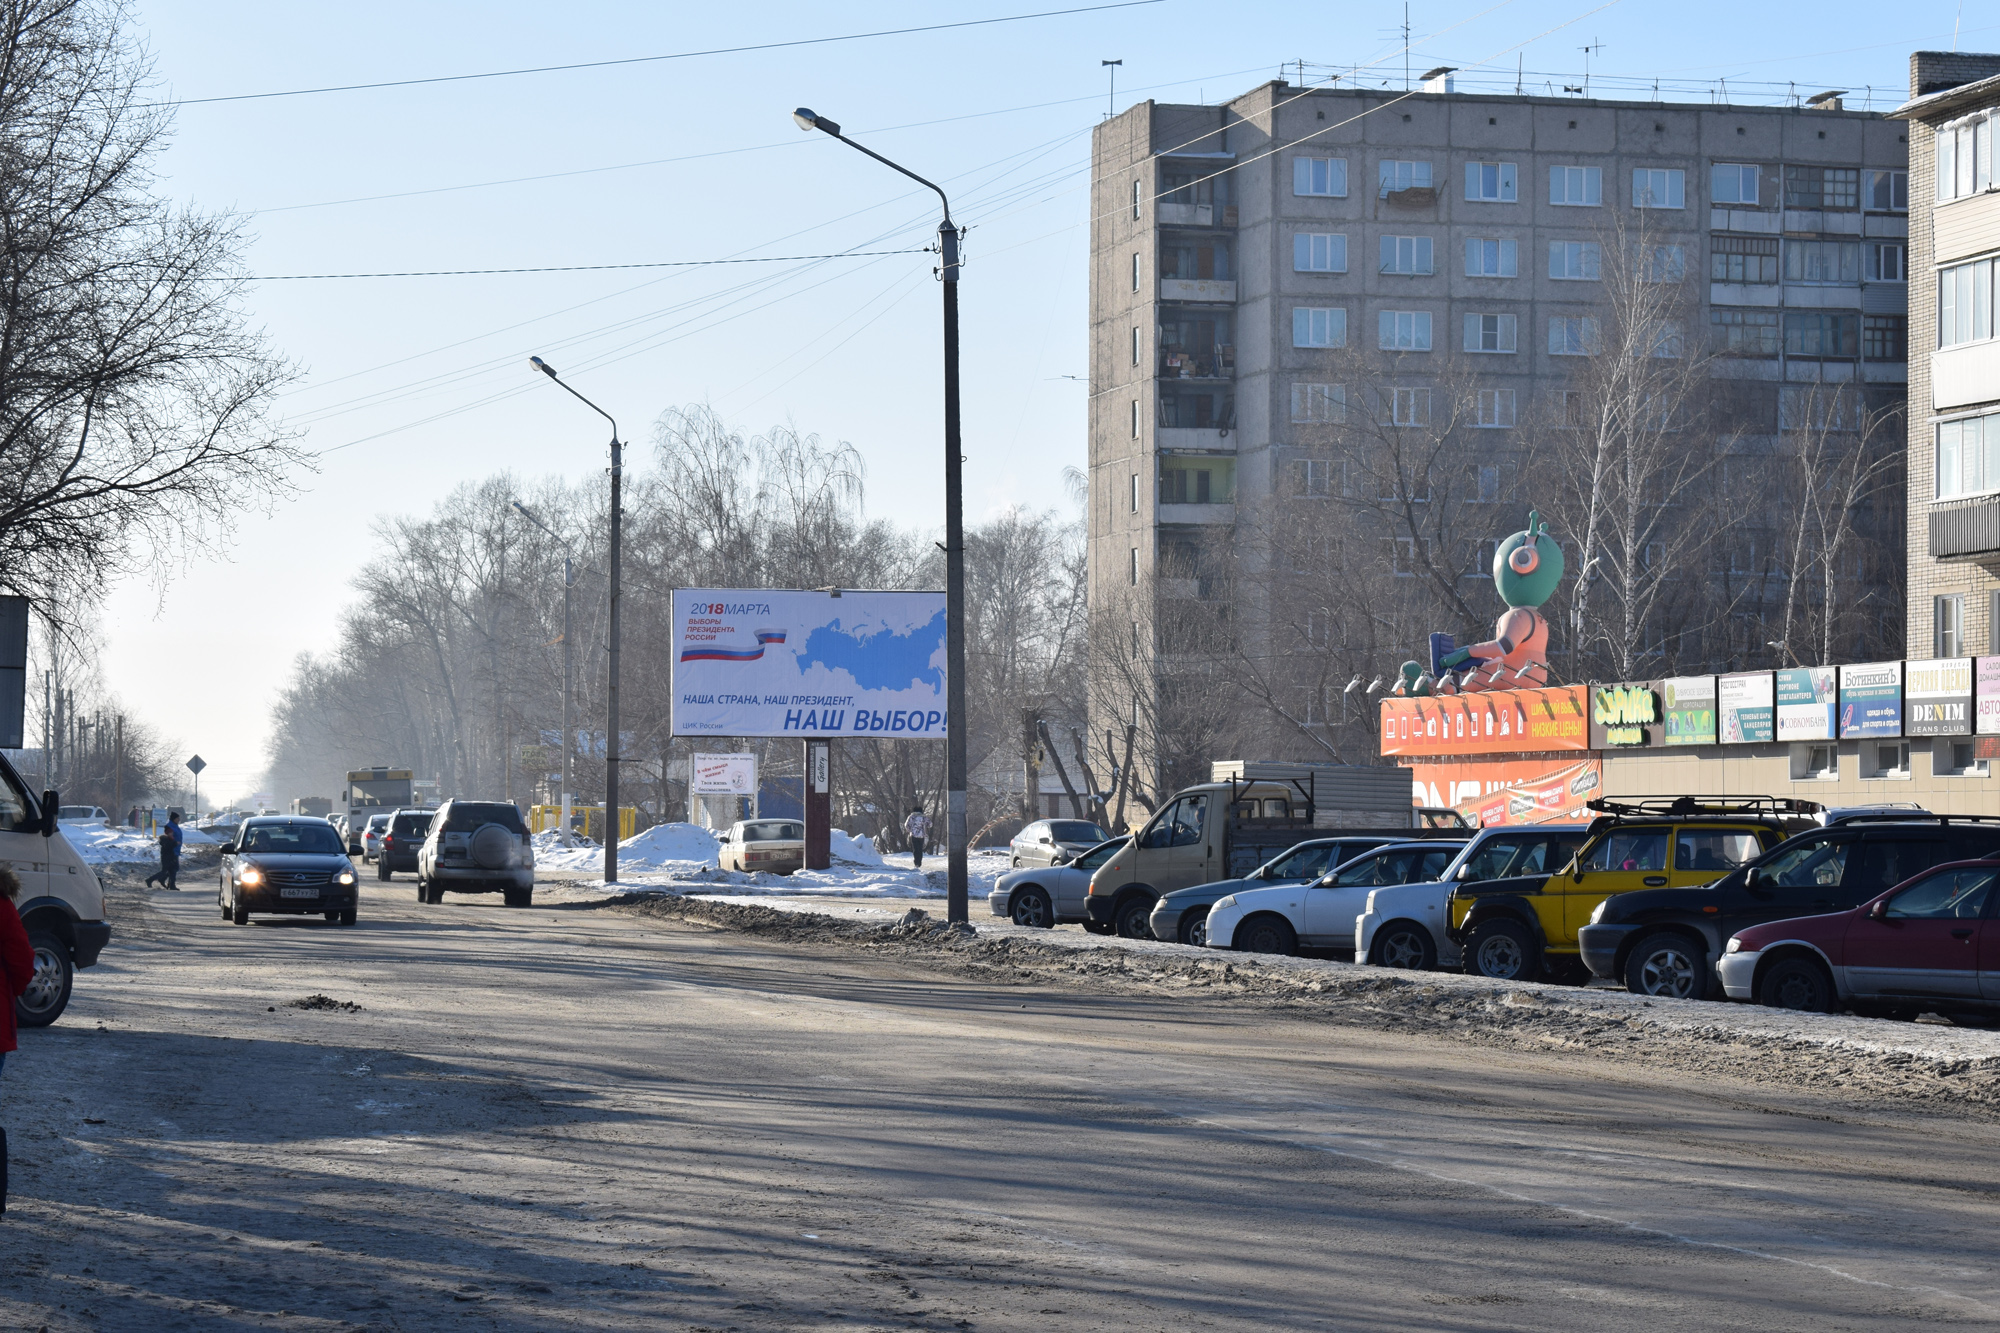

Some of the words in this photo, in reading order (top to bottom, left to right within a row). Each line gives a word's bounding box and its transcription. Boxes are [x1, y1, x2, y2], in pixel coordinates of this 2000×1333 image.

[687, 626, 735, 634] ПРЕЗИДЕНТА
[1778, 674, 1792, 682] СУМКИ
[1907, 670, 1939, 693] ВЕРХНЯЯ
[1941, 668, 1970, 695] ОДЕЖДА
[1778, 683, 1800, 691] ПОРТМОНЕ
[682, 694, 715, 704] НАША
[717, 694, 761, 706] СТРАНА,
[763, 695, 789, 705] НАШ
[791, 695, 855, 707] ПРЕЗИДЕНТ,
[1778, 692, 1812, 701] КОЖГАЛАНТЕРЕЯ
[1531, 699, 1559, 716] ШИРОКИЙ
[1884, 707, 1895, 717] обувь
[1913, 703, 1965, 722] DENIM
[783, 709, 845, 731] НАШ
[853, 709, 948, 732] ВЫБОР!
[1744, 721, 1771, 729] КАНЦЕЛЯРИЯ
[1785, 716, 1827, 728] СОВКОМБАНК
[1870, 720, 1882, 728] спорта
[1886, 719, 1900, 727] отдыха
[1531, 721, 1558, 738] НИЗКИЕ
[1560, 720, 1582, 739] ЦЕНЫ!
[1912, 725, 1939, 733] JEANS
[1943, 724, 1965, 732] CLUB
[817, 756, 828, 783] Gallery
[1494, 804, 1505, 813] СТАРОЕ
[1491, 814, 1501, 823] НОВОЕ
